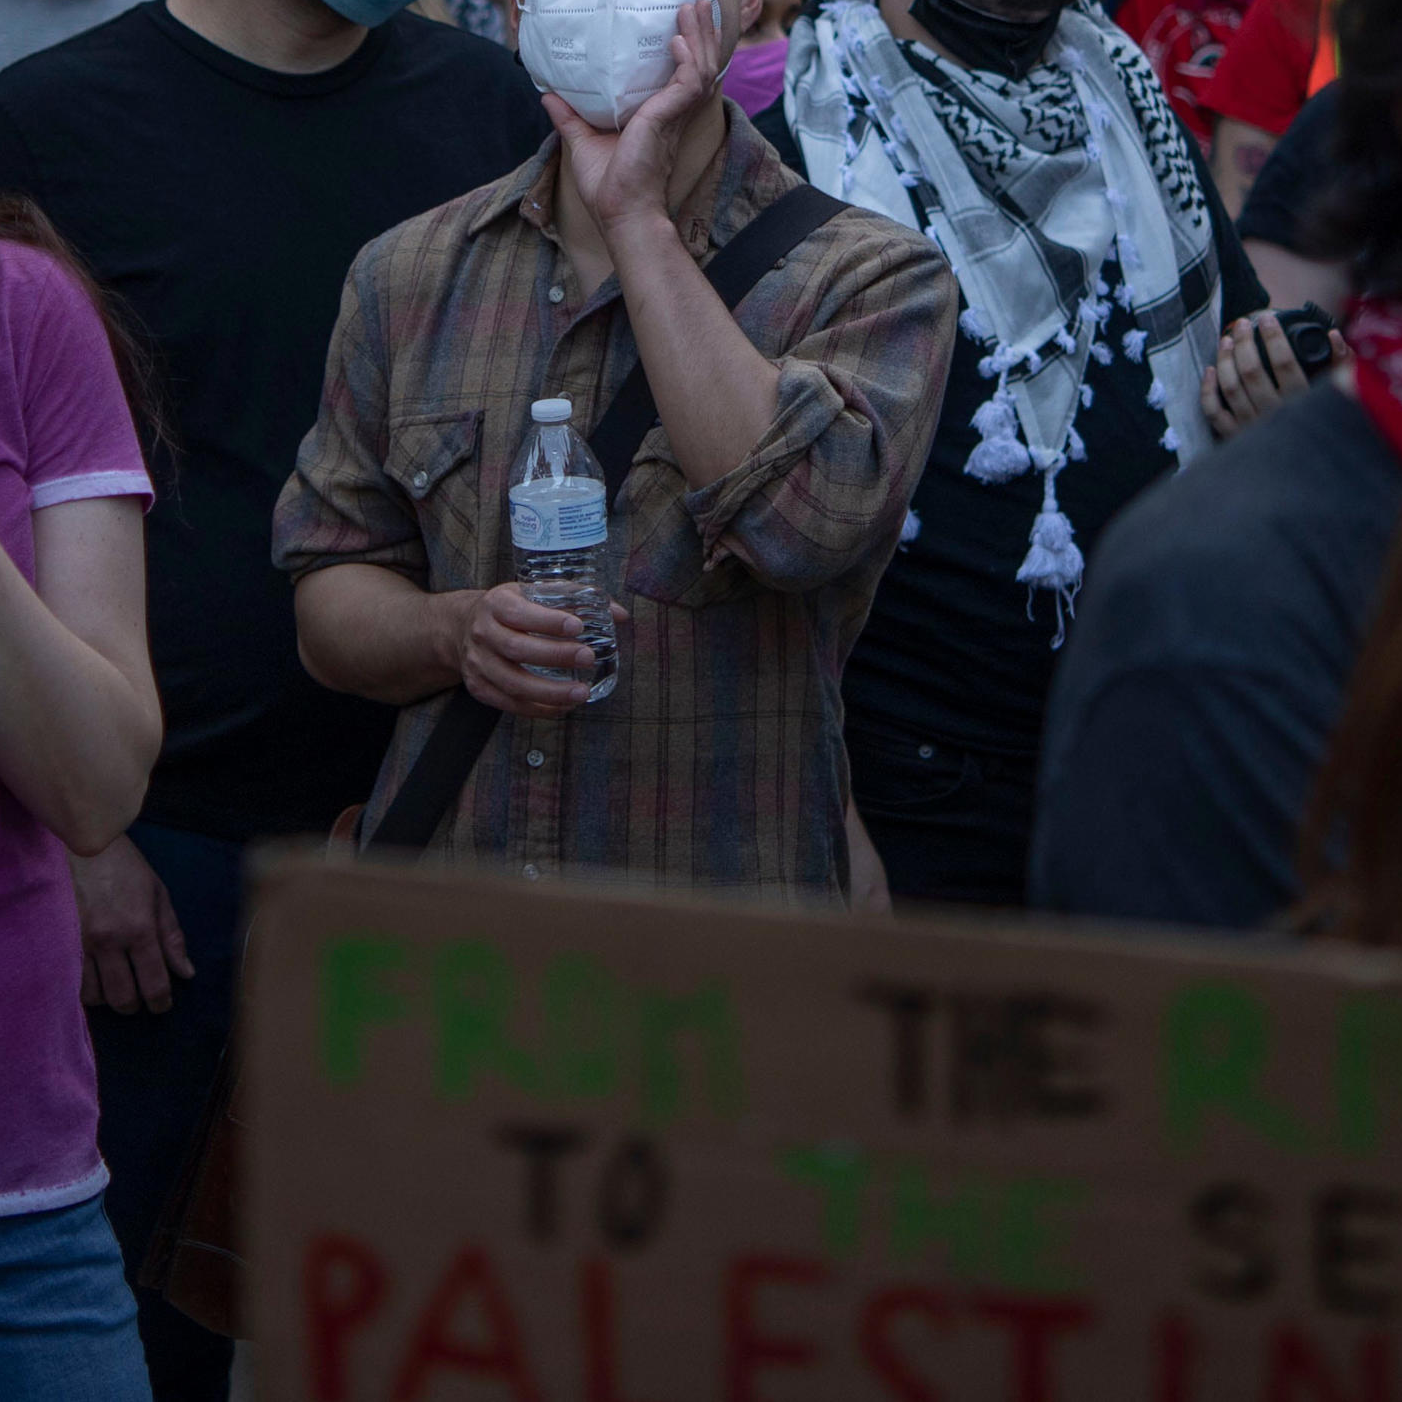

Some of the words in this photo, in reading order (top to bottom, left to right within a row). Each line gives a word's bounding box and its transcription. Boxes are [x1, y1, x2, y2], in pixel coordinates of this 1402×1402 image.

[551, 37, 575, 49] KN95
[637, 35, 663, 48] KN95
[318, 933, 748, 1126] FROM
[862, 977, 1104, 1126] THE
[493, 1120, 670, 1249] TO
[772, 1139, 1093, 1294] THE
